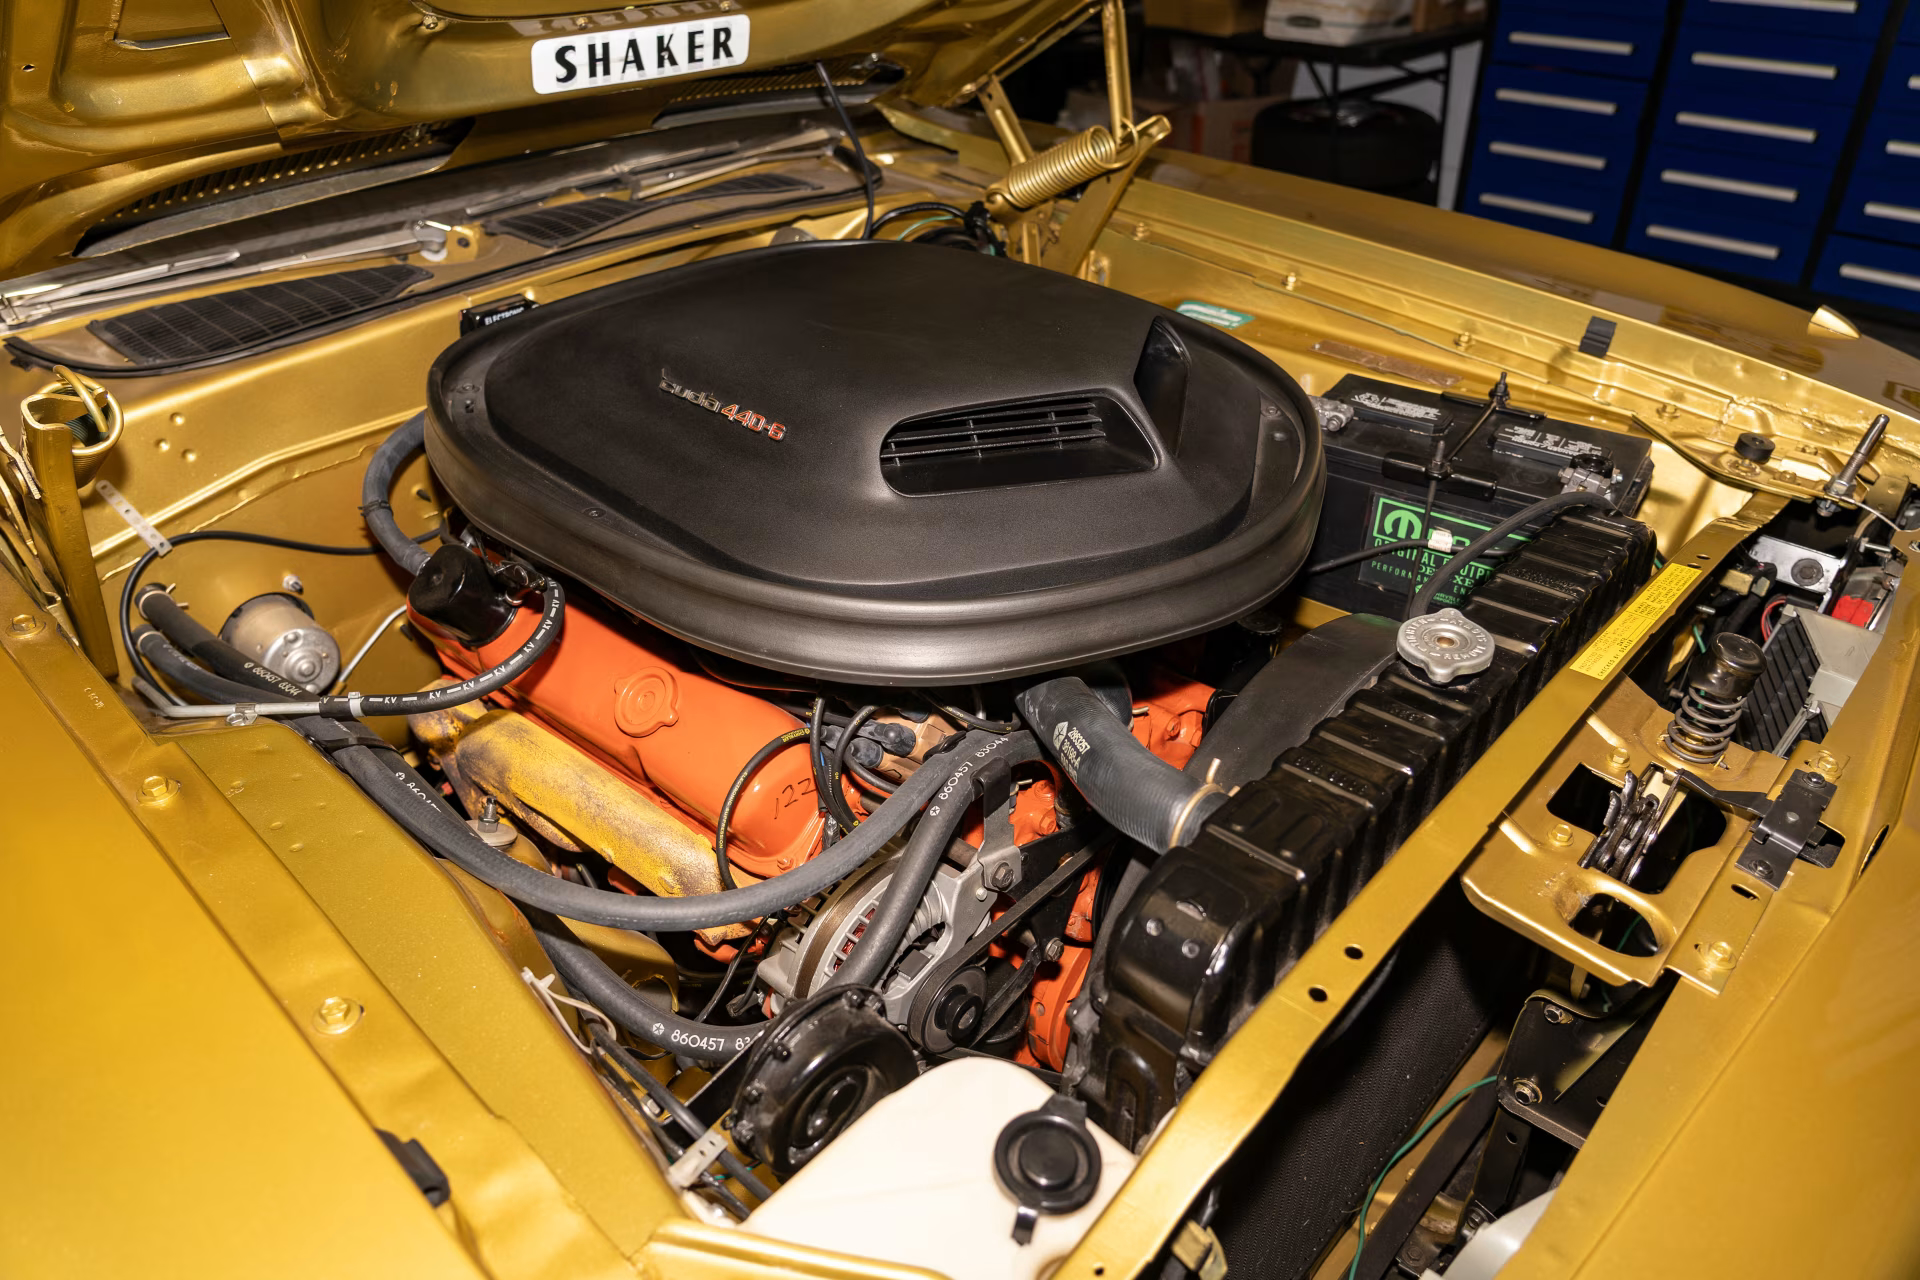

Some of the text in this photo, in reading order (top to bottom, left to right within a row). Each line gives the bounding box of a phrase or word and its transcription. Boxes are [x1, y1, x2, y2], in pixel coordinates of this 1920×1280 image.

[554, 27, 734, 84] SHAKER
[721, 403, 786, 441] 440-6
[384, 696, 397, 704] KV
[429, 690, 441, 700] KV
[462, 681, 475, 692] KV
[493, 665, 506, 677] KV
[523, 641, 535, 653] KV
[542, 619, 553, 630] KV
[938, 736, 1008, 801] 860457 83044
[671, 1029, 725, 1052] 860457
